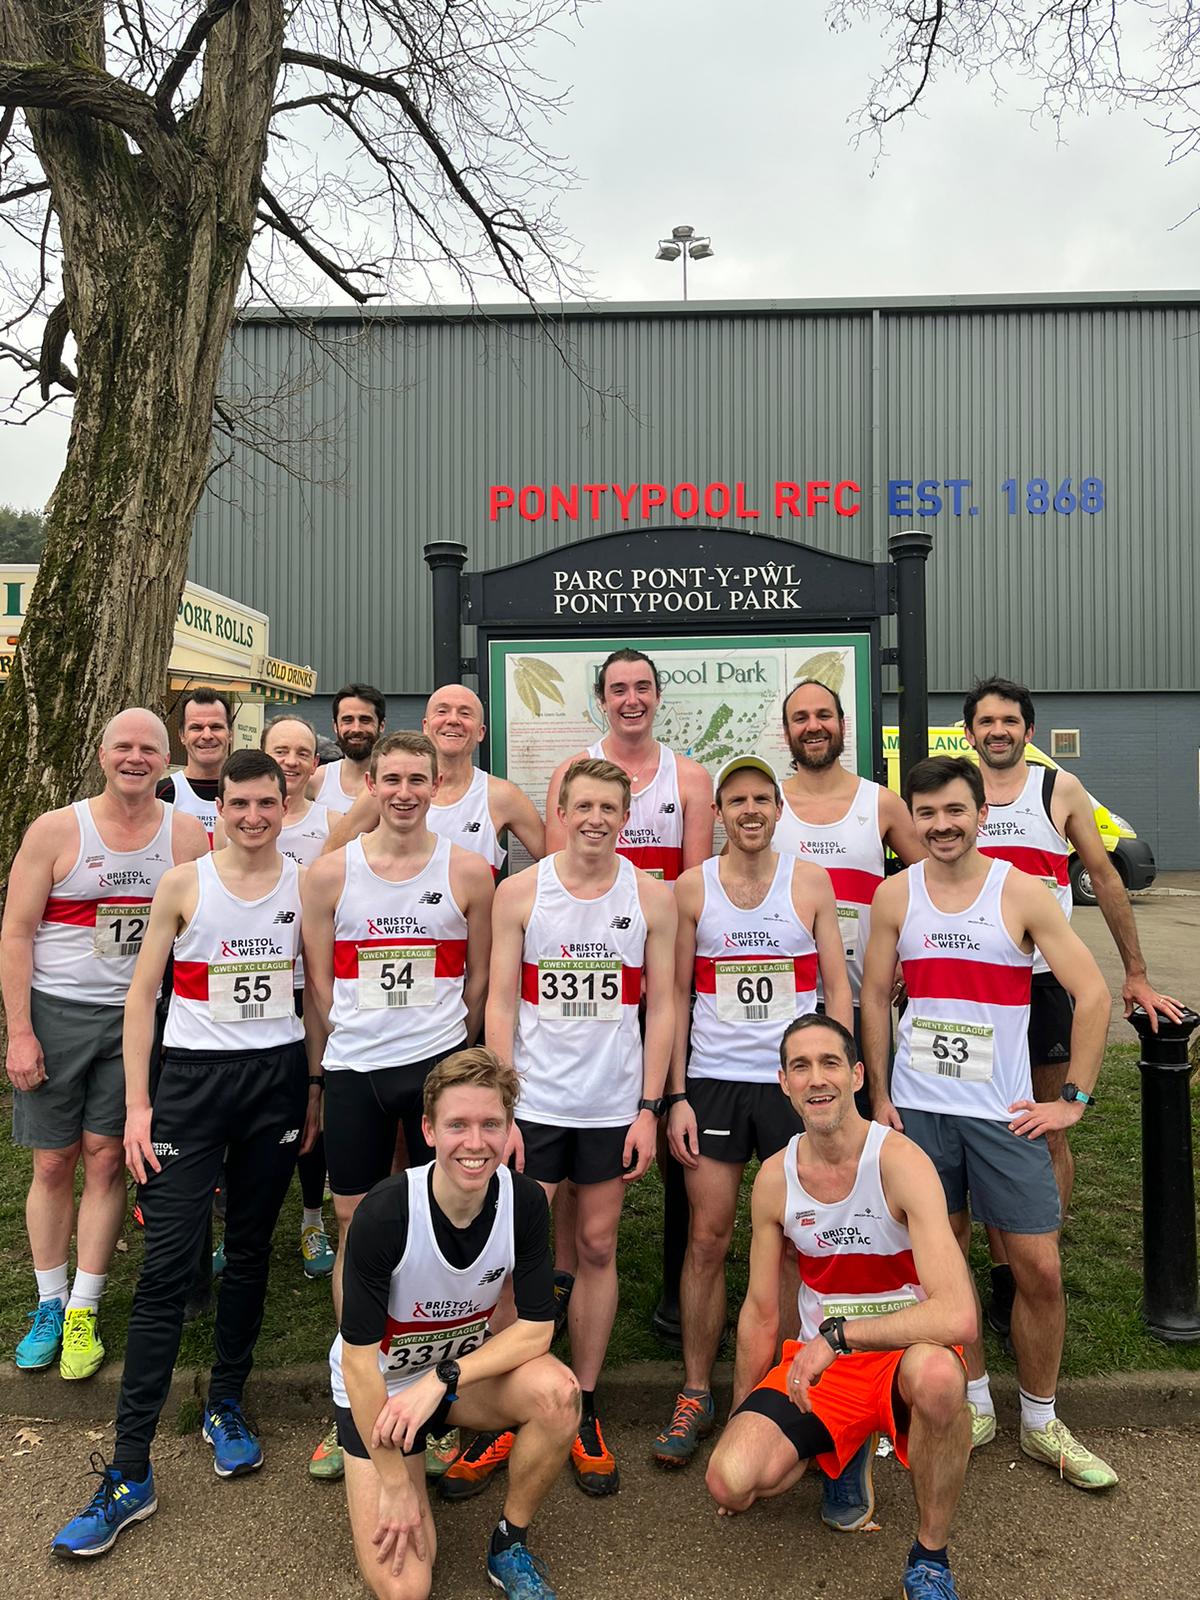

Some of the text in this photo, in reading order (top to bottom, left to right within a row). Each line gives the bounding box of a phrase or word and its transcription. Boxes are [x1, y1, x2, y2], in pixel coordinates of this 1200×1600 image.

[489, 476, 1105, 521] PONTYPOOL RFC EST. 1868
[553, 561, 801, 591] PARC PONT-Y-PŴL
[554, 589, 802, 614] PONTYPOOL PARK
[215, 613, 253, 648] ROLLS
[266, 660, 313, 688] COLD DRINKS
[716, 659, 767, 683] Park
[983, 822, 1018, 831] BRISTOL
[624, 829, 655, 837] BRISTOL
[630, 836, 661, 844] WEST AC
[107, 871, 144, 880] BRISTOL
[113, 878, 138, 886] WEST
[377, 917, 418, 926] BRISTOL
[110, 918, 149, 943] 12
[384, 925, 427, 935] WEST AC
[732, 931, 771, 940] BRISTOL
[931, 933, 972, 942] BRISTOL
[231, 938, 274, 948] BRISTOL
[569, 943, 608, 951] BRISTOL
[739, 939, 780, 948] WEST AC
[938, 941, 981, 950] WEST AC
[239, 946, 283, 957] WEST AC
[362, 951, 389, 960] GWENT
[401, 950, 432, 958] LEAGUE
[213, 961, 289, 973] GWENT XC LEAGUE
[543, 961, 617, 969] GWENT XC LEAGUE
[720, 965, 745, 973] GWENT
[760, 963, 790, 972] LEAGUE
[380, 962, 415, 991] 54
[233, 975, 272, 1004] 55
[541, 972, 619, 1001] 3315
[737, 976, 773, 1005] 60
[916, 1020, 989, 1036] GWENT XC LEAGUE
[932, 1034, 970, 1064] 53
[822, 1227, 861, 1240] BRISTOL
[831, 1236, 872, 1246] WEST AC
[425, 1300, 474, 1310] BRISTOL
[829, 1304, 859, 1314] GWENT
[861, 1304, 874, 1313] XC
[431, 1303, 481, 1318] WEST AC
[397, 1335, 429, 1346] GWENT
[446, 1324, 481, 1339] LEAGUE
[388, 1336, 478, 1371] 3316
